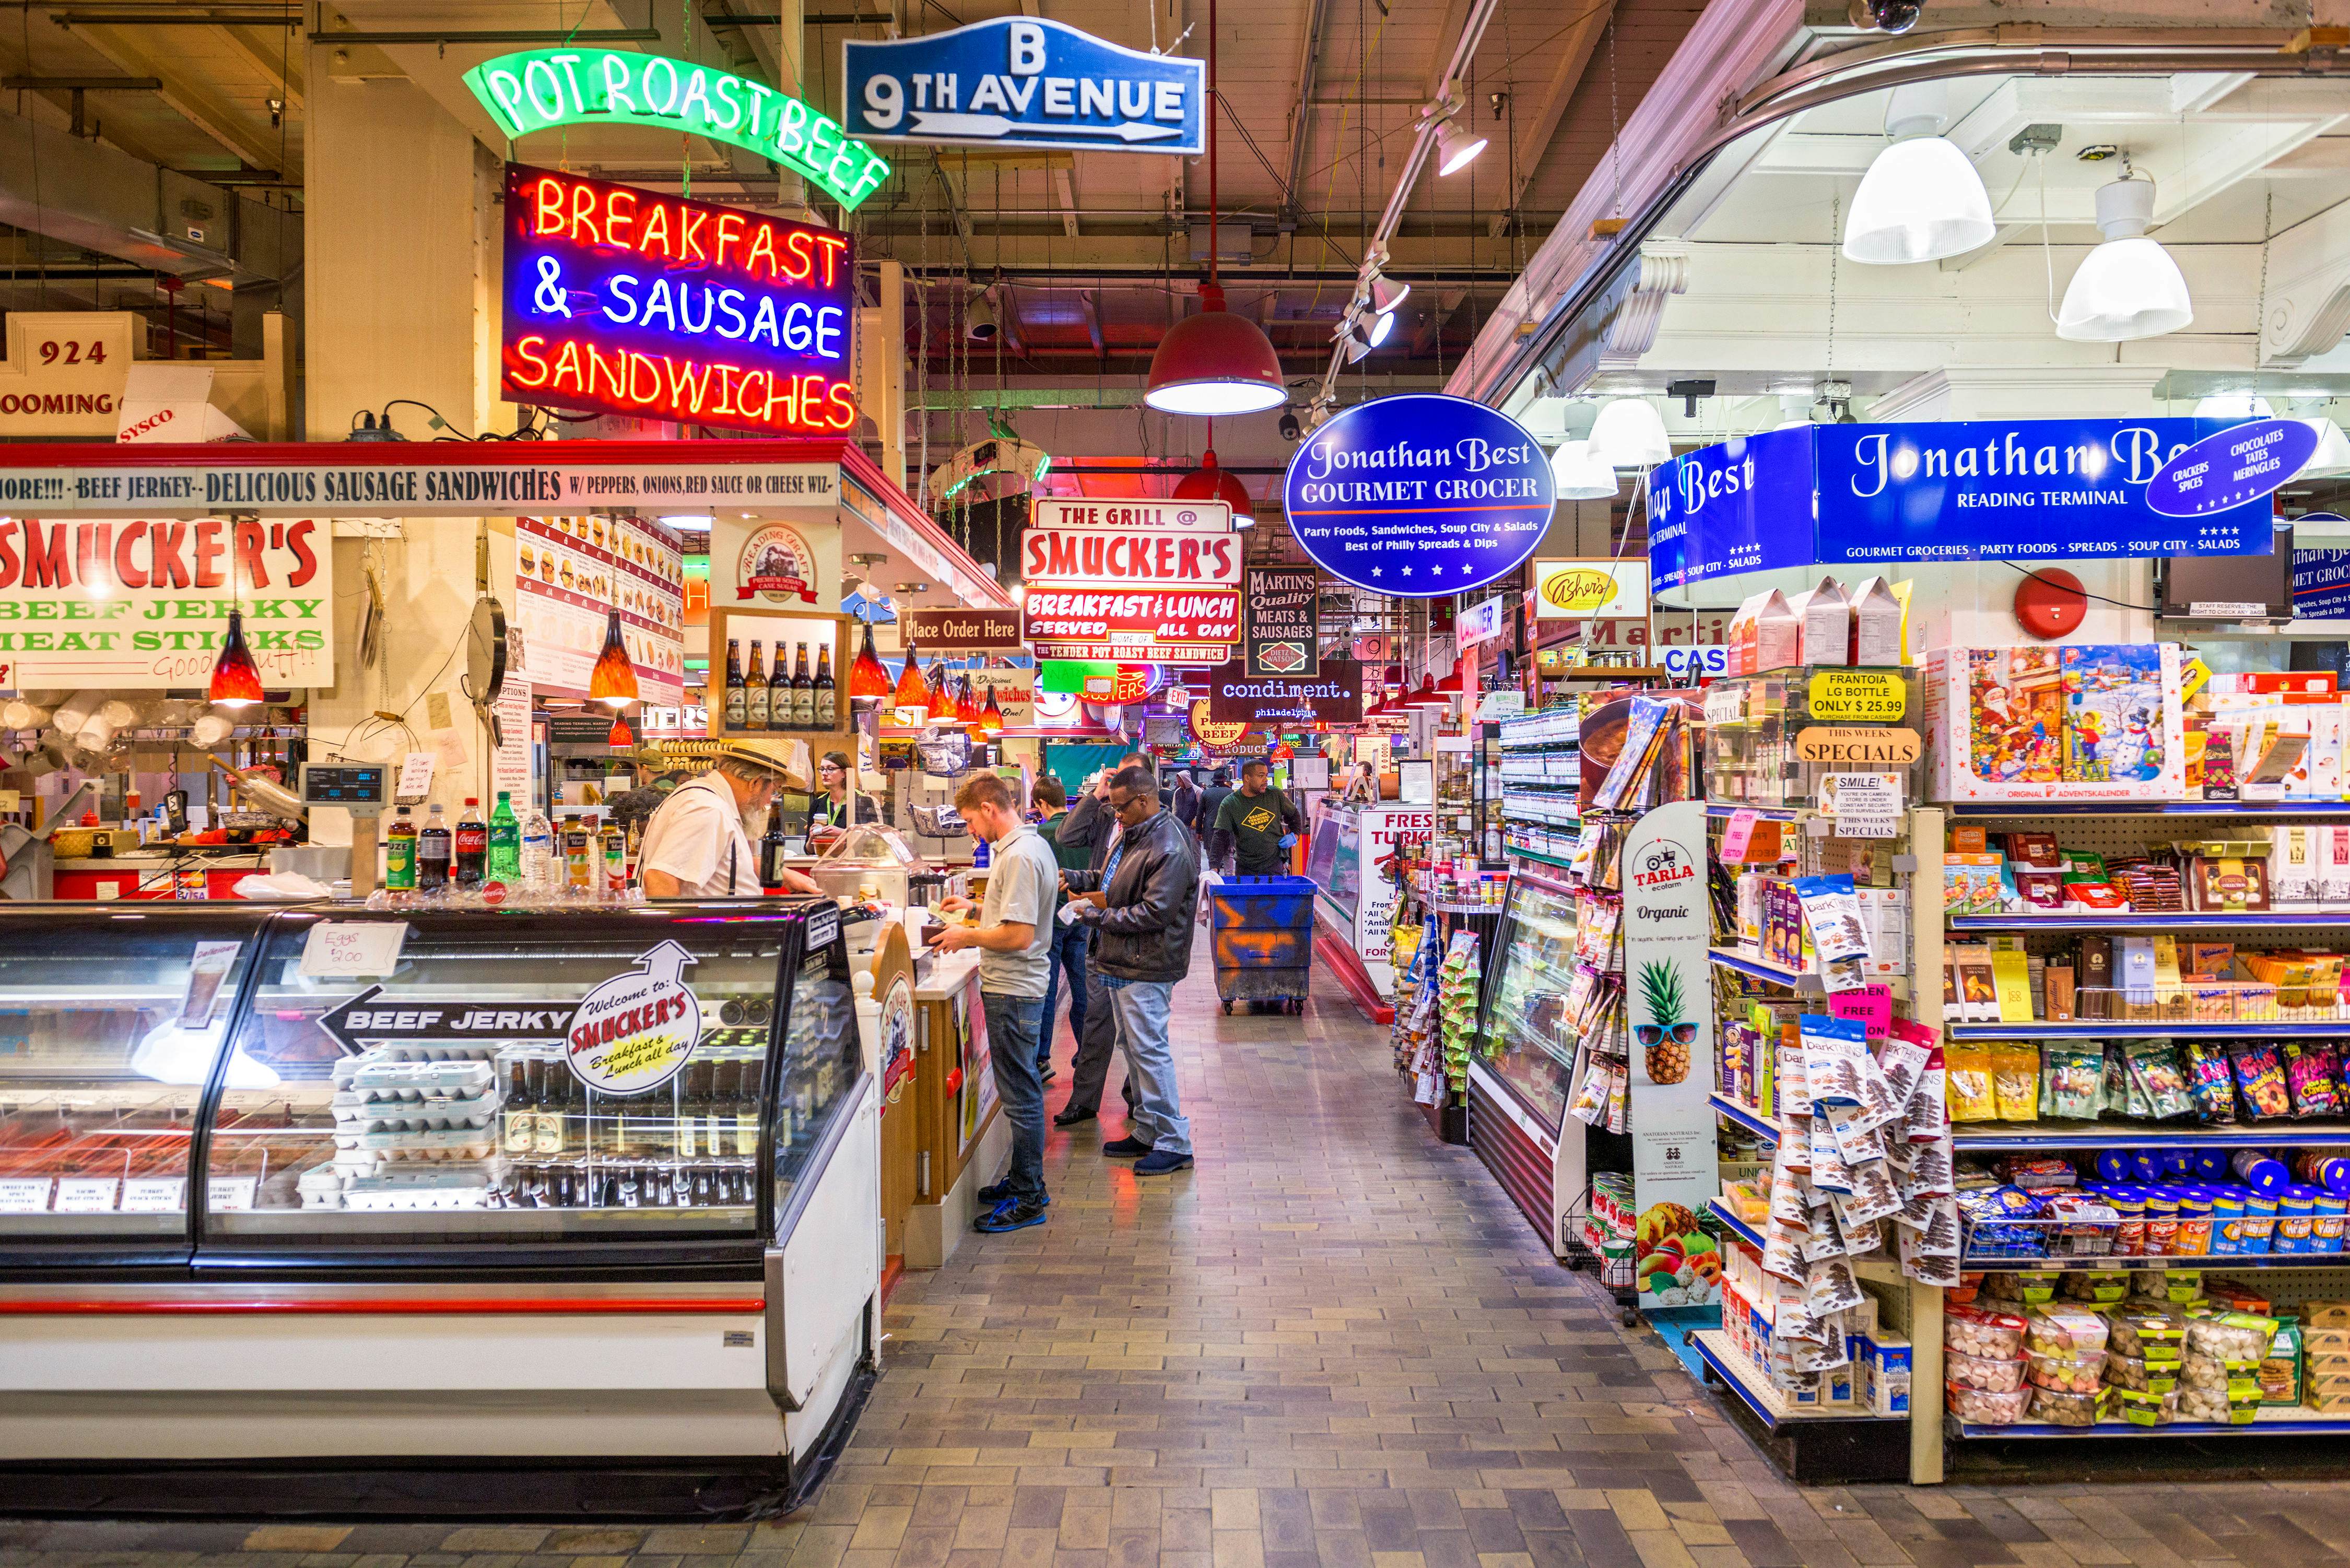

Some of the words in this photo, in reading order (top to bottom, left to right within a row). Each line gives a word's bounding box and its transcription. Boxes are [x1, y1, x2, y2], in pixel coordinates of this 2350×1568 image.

[1010, 22, 1045, 76] B
[863, 73, 957, 129] 9TH
[969, 75, 1185, 121] AVENUE
[489, 54, 584, 132] POT
[603, 54, 772, 136] ROAST
[776, 99, 891, 197] BEEF
[535, 179, 845, 288] BREAKFAST
[533, 255, 572, 319] &
[602, 273, 843, 359] SAUSAGE
[40, 341, 107, 364] 924
[511, 336, 855, 429] SANDWICHES
[119, 409, 174, 443] SYSCO
[2230, 429, 2284, 457] CHOCOLATES
[1307, 440, 1452, 479] Jonathan
[1456, 438, 1531, 472] Best
[1851, 432, 2093, 498] Jonathan
[2246, 447, 2269, 464] TATES
[2172, 461, 2209, 482] CRACKERS
[2233, 457, 2281, 481] MERINGUES
[77, 477, 122, 499] BEEF
[127, 476, 192, 500] JERKEY
[206, 471, 315, 502] DELICIOUS
[324, 471, 417, 501] SAUSAGE
[426, 470, 561, 501] SANDWICHES
[570, 476, 584, 496] W/
[588, 476, 639, 496] PEPPERS,
[711, 476, 744, 494] SAUCE
[747, 476, 762, 493] OR
[766, 476, 805, 494] CHEESE
[1301, 481, 1427, 503] GOURMET
[1435, 478, 1538, 500] GROCER
[1678, 453, 1755, 514] Best
[2179, 476, 2203, 493] SPICES
[1957, 492, 2035, 508] READING
[2041, 490, 2128, 506] TERMINAL
[1059, 507, 1098, 524] THE
[1106, 508, 1166, 526] GRILL
[1176, 511, 1197, 526] @
[1305, 527, 1331, 538] Party
[1334, 526, 1368, 537] Foods,
[1371, 524, 1437, 536] Sandwiches,
[1440, 523, 1467, 535] Soup
[1471, 523, 1490, 533] City
[1494, 523, 1501, 532] &
[1504, 521, 1538, 532] Salads
[1656, 522, 1687, 541] TERMINAL
[0, 520, 318, 589] SMUCKER'S
[742, 530, 784, 574] READING
[1345, 541, 1368, 551] Best
[1371, 541, 1383, 550] of
[1386, 540, 1415, 552] Philly
[1418, 539, 1460, 551] Spreads
[1463, 539, 1471, 548] &
[1474, 538, 1498, 549] Dips
[1846, 546, 1904, 557] GOURMET
[1907, 545, 1969, 556] GROCERIES
[1980, 545, 2014, 554] PARTY
[2017, 543, 2058, 553] FOODS
[2068, 541, 2117, 552] SPREADS
[2128, 540, 2159, 551] SOUP
[2163, 540, 2188, 550] CITY
[2198, 539, 2240, 549] SALADS
[1027, 532, 1232, 580] SMUCKER'S
[1688, 564, 1705, 576] SOUP
[1706, 562, 1721, 573] CITY
[1728, 555, 1762, 568] SALADS
[1249, 571, 1315, 595] MARTIN'S
[0, 600, 133, 620] BEEF
[143, 599, 325, 620] JERKY
[1027, 594, 1155, 618] BREAKFAST
[1166, 596, 1236, 619] LUNCH
[1250, 592, 1315, 610] Quality
[1256, 610, 1295, 623] MEATS
[1299, 610, 1308, 623] &
[2309, 609, 2328, 618] Spreads
[905, 620, 939, 638] Place
[943, 619, 980, 638] Order
[984, 619, 1015, 638] Here
[1029, 621, 1108, 635] SERVED
[1156, 623, 1189, 636] ALL
[1197, 623, 1237, 638] DAY
[1252, 626, 1313, 640] SAUSAGES
[1049, 645, 1089, 658] TENDER
[1092, 647, 1111, 658] POT
[1113, 647, 1145, 659] ROAST
[1147, 647, 1172, 659] BEEF
[1174, 648, 1225, 661] SANDWICH
[1830, 675, 1887, 684] FRANTOIA
[1171, 690, 1187, 705] EXIT
[1223, 680, 1351, 699] condiment.
[1827, 688, 1842, 697] LG
[1846, 688, 1890, 697] BOTTLE
[1814, 700, 1852, 712] ONLY
[1855, 700, 1863, 713] $
[1867, 701, 1902, 712] 25.99
[1203, 730, 1238, 738] BEEF
[1828, 729, 1852, 737] THIS
[1203, 741, 1220, 750] SINCE
[1221, 741, 1237, 750] 1954
[1805, 743, 1913, 761] SPECIALS
[1839, 777, 1880, 787] SMILE!
[2058, 789, 2130, 798] ADVENTSKALENDER
[1248, 815, 1270, 823] TERMINAL
[1839, 827, 1893, 836] SPECIALS
[1634, 865, 1695, 887] TARLA
[1652, 880, 1682, 892] ecofarm
[1637, 905, 1689, 923] Organic
[325, 932, 359, 947] Eggs
[585, 987, 650, 1016] Welcome
[651, 978, 670, 997] to:
[344, 1010, 444, 1030] BEEF
[450, 1010, 574, 1030] JERKY
[1843, 1006, 1874, 1015] FREE
[570, 991, 688, 1056] SMUCKER'S
[590, 1039, 655, 1071] Breakfast
[1805, 1039, 1863, 1058] barkTHINS
[602, 1055, 643, 1081] Lunch
[663, 1040, 690, 1059] day
